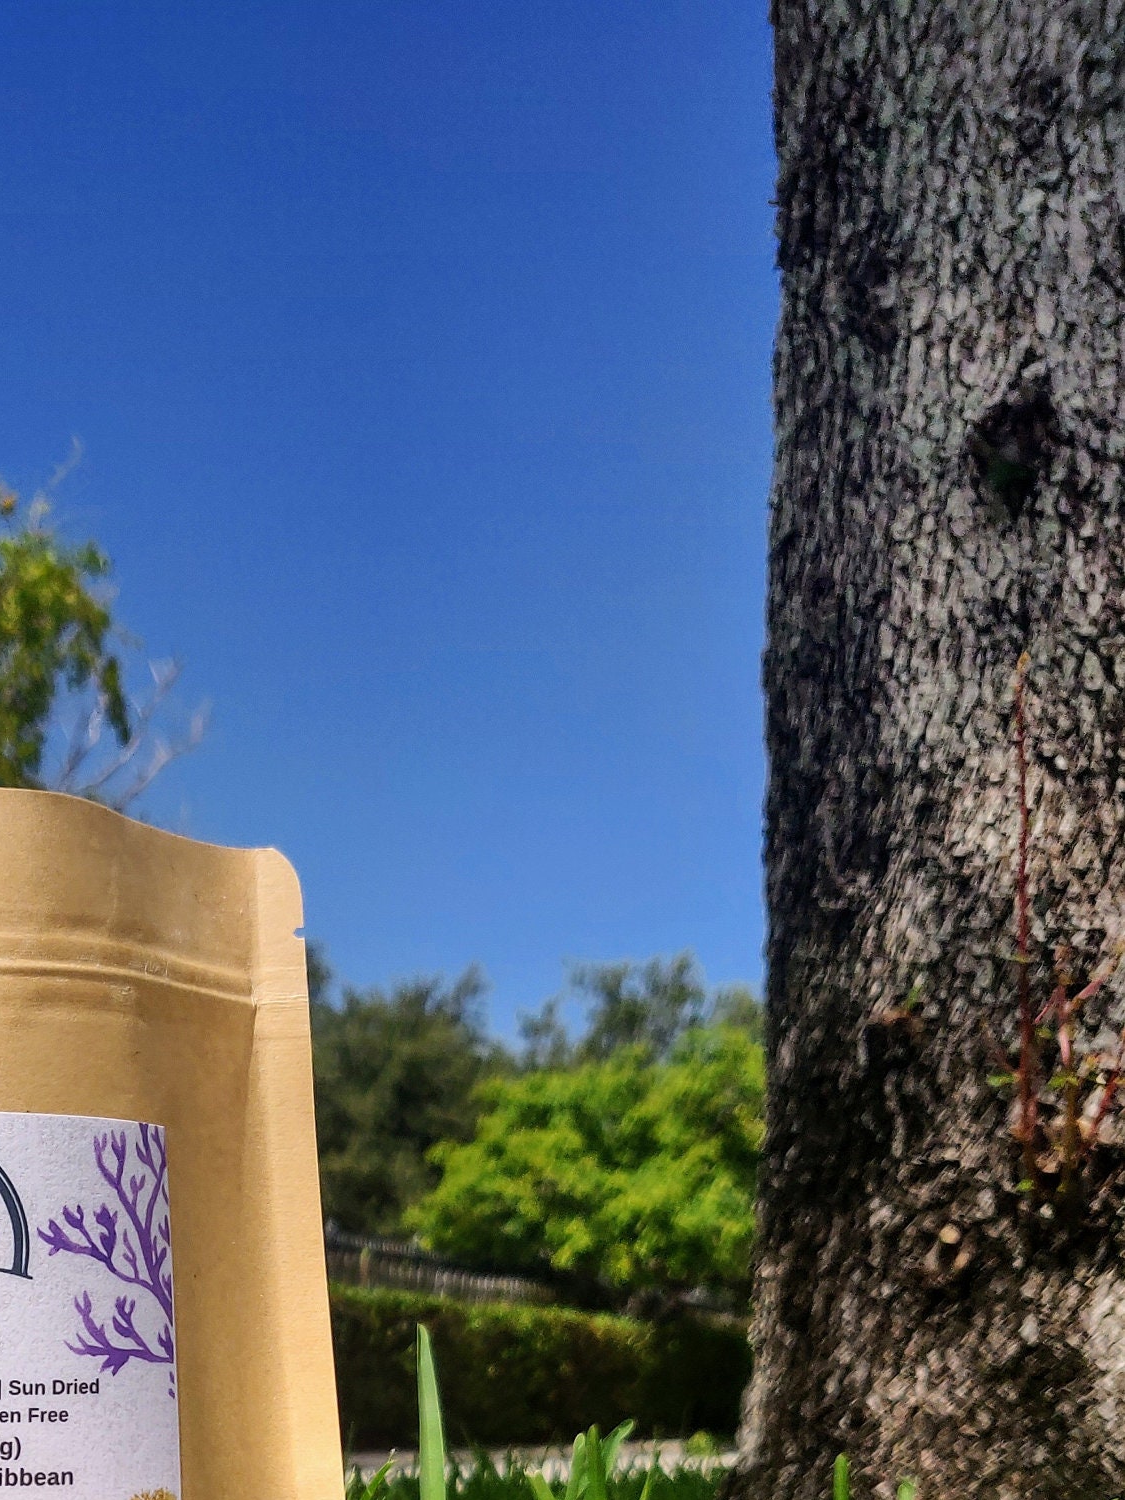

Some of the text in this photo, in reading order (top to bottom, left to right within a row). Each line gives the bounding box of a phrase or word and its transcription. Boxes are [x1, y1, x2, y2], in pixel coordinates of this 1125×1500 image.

[8, 1379, 46, 1396] Sun
[52, 1377, 100, 1396] Dried
[28, 1407, 69, 1423] Free
